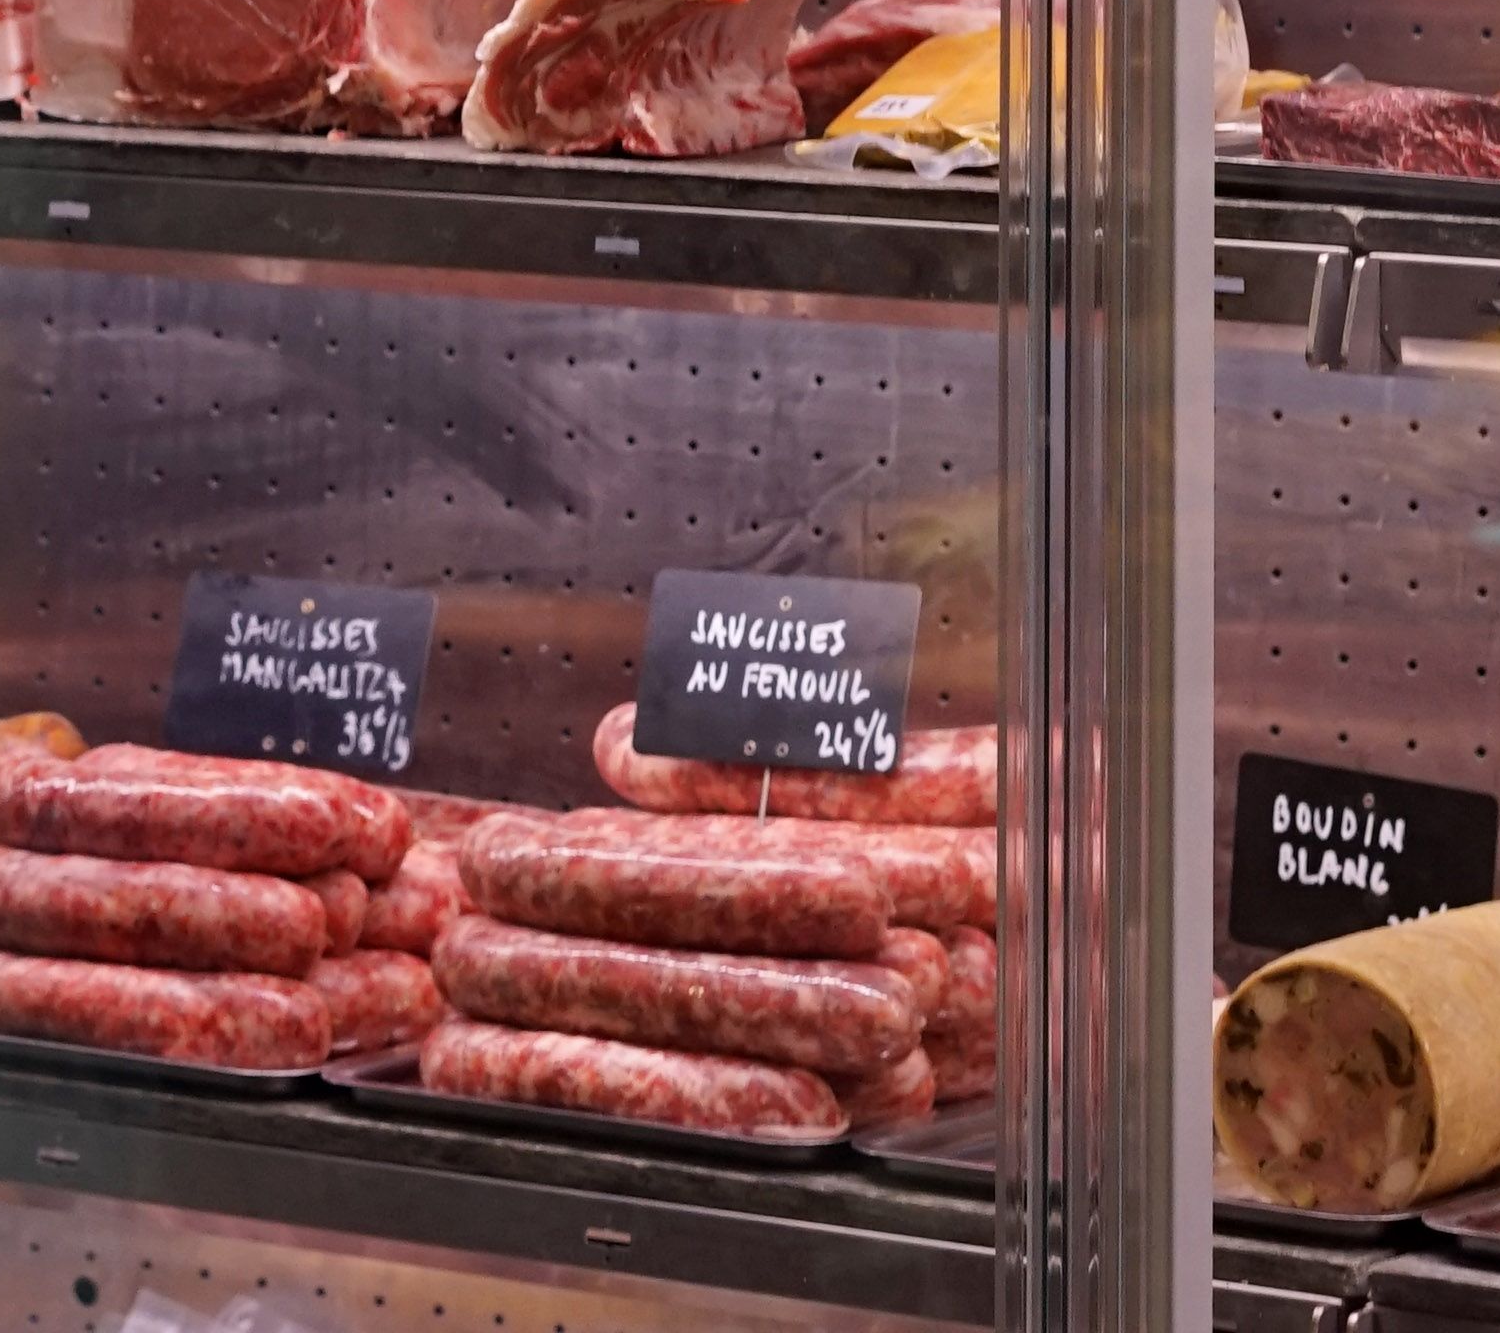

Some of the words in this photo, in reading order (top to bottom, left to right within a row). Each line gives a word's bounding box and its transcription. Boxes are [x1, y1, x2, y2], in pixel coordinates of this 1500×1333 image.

[225, 611, 380, 657] SAUCISSES
[691, 609, 846, 657] SAUCISSES
[687, 660, 728, 693] AU
[742, 662, 870, 705] FENOUIL
[1273, 794, 1405, 853] BOUDIN
[1278, 841, 1390, 896] BLANC
